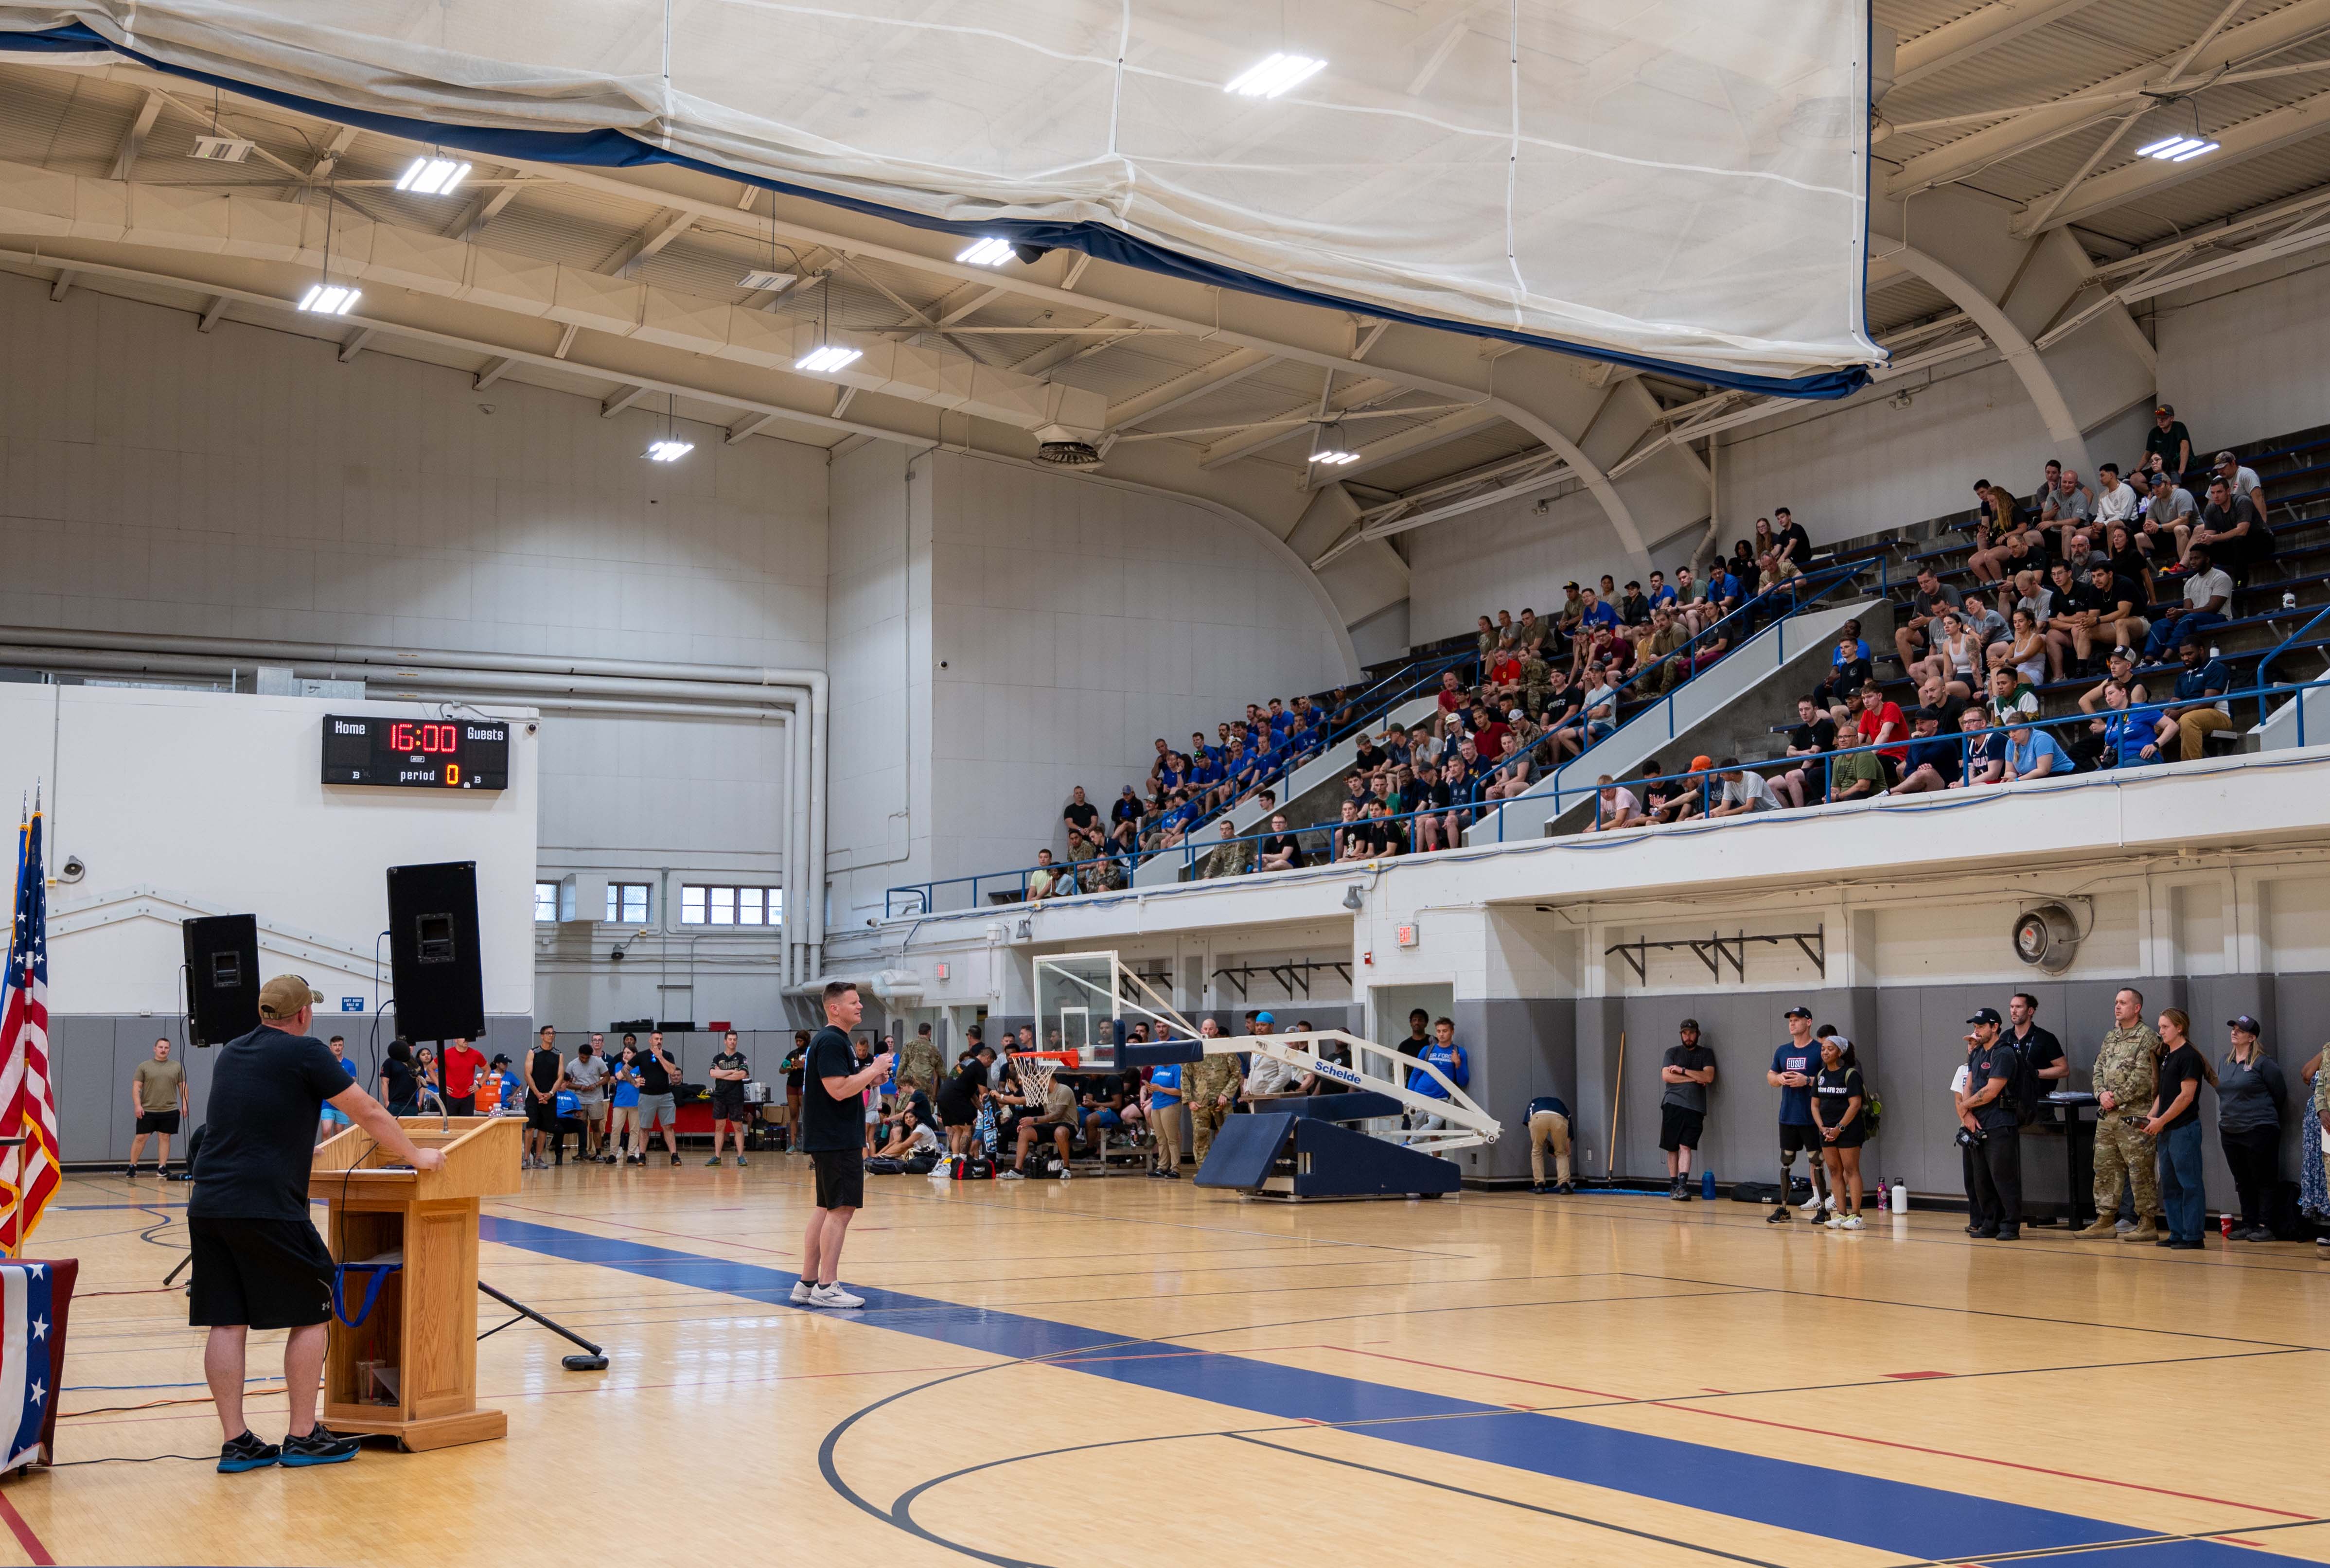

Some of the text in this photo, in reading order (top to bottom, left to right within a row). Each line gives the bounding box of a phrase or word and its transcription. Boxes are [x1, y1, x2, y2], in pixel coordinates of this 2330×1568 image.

[335, 721, 365, 735] Home
[467, 726, 504, 740] Guests
[391, 723, 456, 752] 16:00
[400, 764, 459, 784] period 0
[1790, 1059, 1802, 1068] USO
[1315, 1061, 1361, 1084] Schelde
[984, 1106, 996, 1130] 24
[1048, 1159, 1064, 1171] NIK
